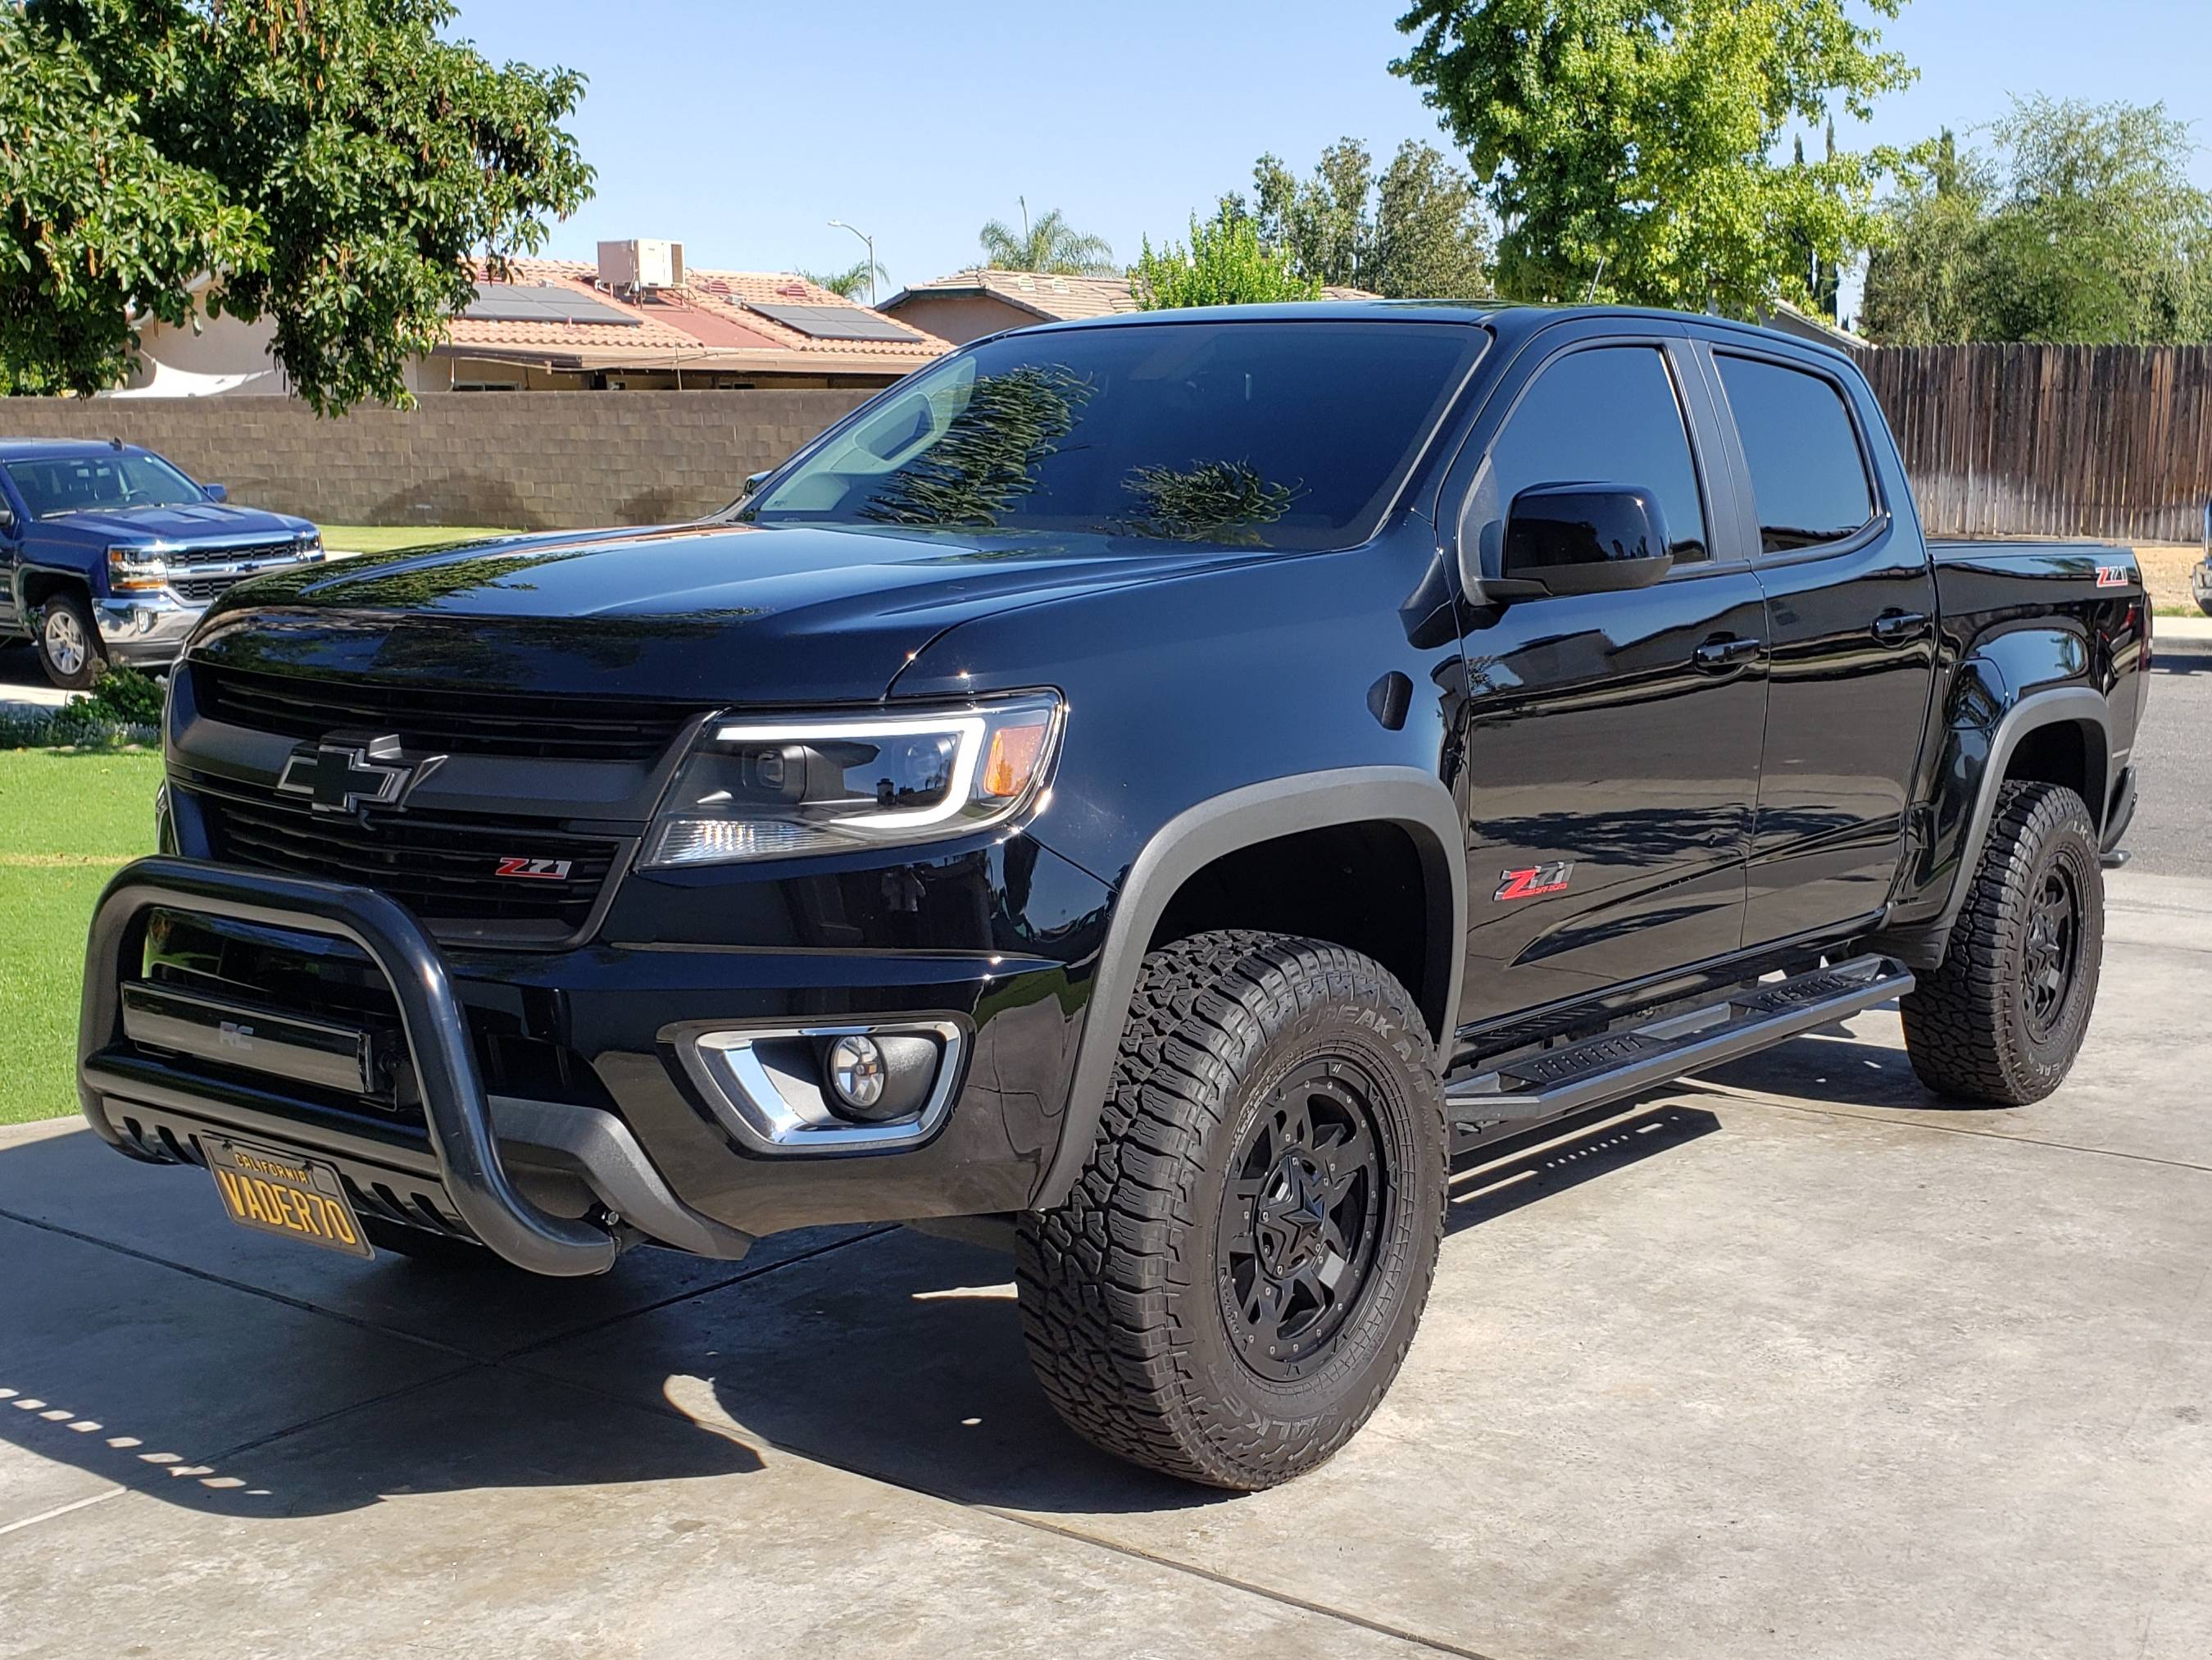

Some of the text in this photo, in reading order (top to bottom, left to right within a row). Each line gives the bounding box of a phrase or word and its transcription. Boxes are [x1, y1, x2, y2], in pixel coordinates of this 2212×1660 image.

[2095, 566, 2128, 588] Z71
[494, 857, 572, 880] Z71
[1492, 862, 1574, 901] Z71
[234, 1153, 310, 1185] CALIFORNIA
[218, 1169, 357, 1244] VADER70
